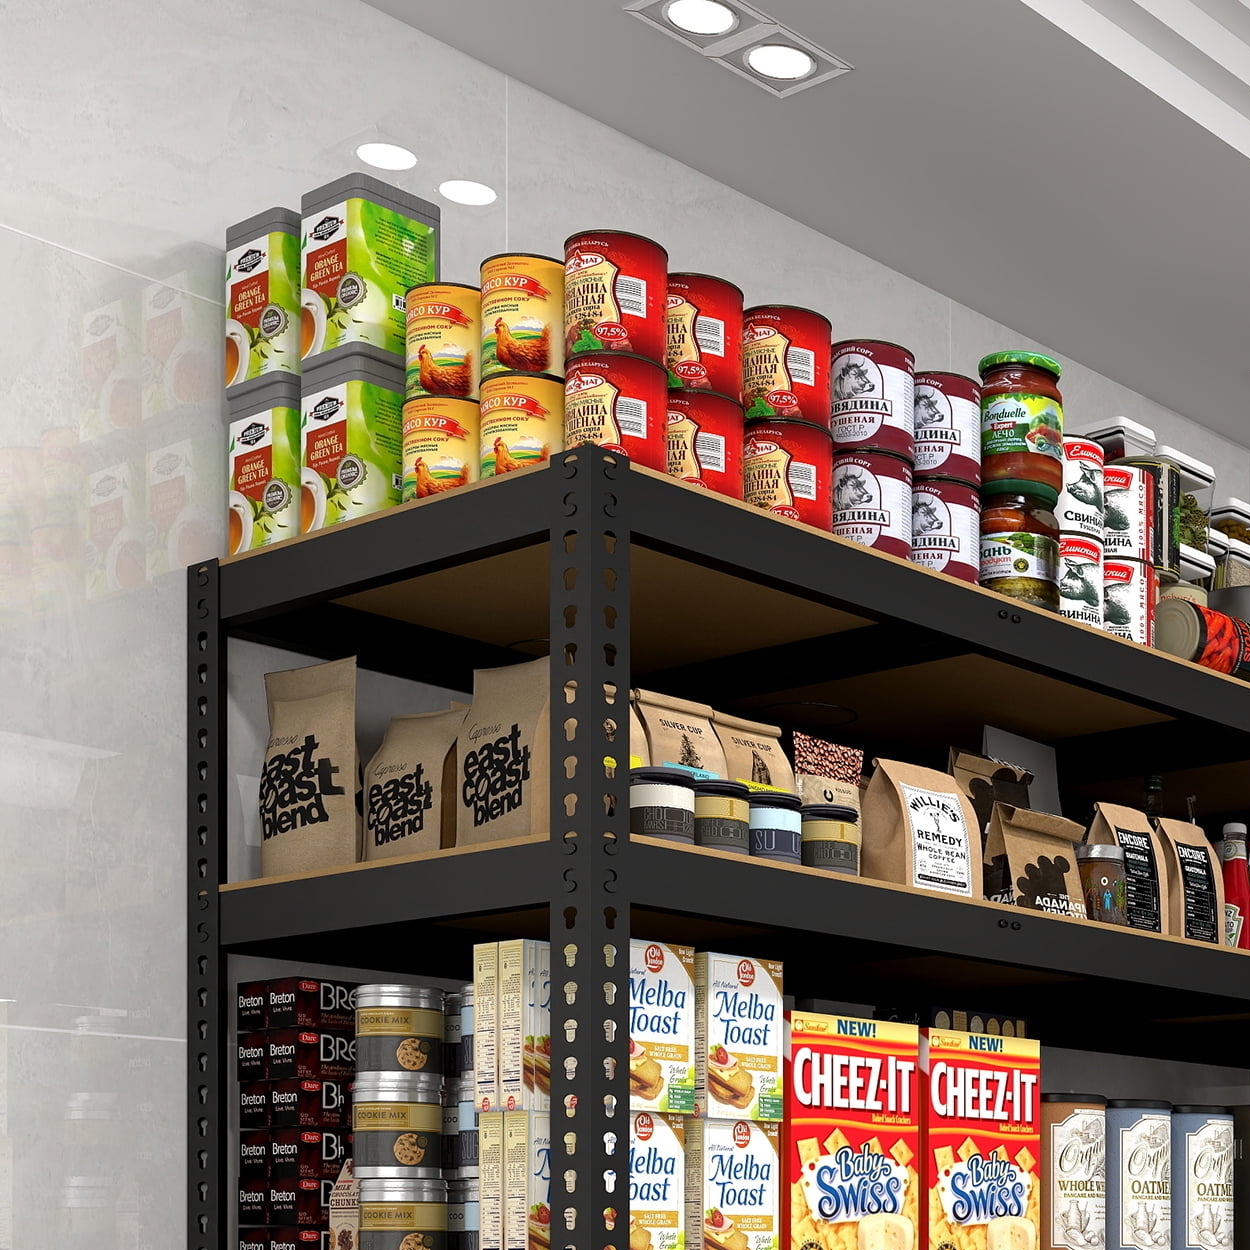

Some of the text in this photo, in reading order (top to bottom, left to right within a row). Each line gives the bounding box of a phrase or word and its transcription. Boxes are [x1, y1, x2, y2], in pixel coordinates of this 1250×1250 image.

[314, 253, 339, 270] ORANGE
[310, 261, 343, 282] GREEN TEA
[504, 275, 528, 287] КУР
[427, 305, 451, 315] КУР
[565, 293, 605, 312] УШЕНАЯ
[856, 346, 874, 357] СОРТ
[926, 379, 943, 388] СОРТ
[504, 396, 527, 407] КУР
[832, 400, 889, 413] ВЯДИНА
[984, 407, 1027, 422] Bonduelle
[992, 430, 1015, 439] ЛЕЧО
[993, 422, 1013, 430] Expert
[314, 434, 339, 450] ORANGE
[914, 430, 957, 441] ЯДИНА
[310, 442, 343, 461] GREEN TEA
[241, 459, 264, 474] ORANGE
[854, 458, 872, 467] СОРТ
[237, 467, 269, 485] GREEN TEA
[833, 511, 886, 523] ВЯДИНА
[1060, 609, 1102, 625] ВИНИНА
[659, 718, 703, 736] SILVER CUP
[463, 723, 522, 774] east
[731, 736, 773, 753] SILVER CUP
[369, 763, 426, 804] east
[462, 744, 531, 808] coast
[367, 780, 433, 830] coast
[473, 786, 523, 828] blend
[910, 796, 960, 823] WILLIE'S
[263, 796, 329, 841] blend
[374, 808, 424, 847] blend
[917, 829, 963, 847] REMEDY
[1118, 832, 1150, 850] ENCORE
[917, 843, 966, 860] WHOLE BEAN
[928, 853, 956, 864] COFFEE
[1177, 845, 1208, 863] ENCORE
[238, 995, 264, 1008] Breton
[269, 992, 296, 1005] Breton
[630, 977, 686, 1009] Melba
[712, 991, 775, 1022] Melba
[360, 1016, 389, 1025] COOKIE
[391, 1016, 409, 1025] MIX
[630, 1006, 681, 1035] Toast
[836, 1019, 877, 1038] NEW!
[720, 1017, 771, 1046] Toast
[238, 1046, 264, 1059] Breton
[269, 1043, 296, 1057] Breton
[968, 1035, 1004, 1053] NEW!
[793, 1047, 915, 1113] CHEEZ-IT
[272, 1091, 298, 1105] Breton
[931, 1061, 1037, 1123] CHEEZ-IT
[708, 1154, 771, 1181] Melba
[836, 1143, 891, 1183] Baby
[968, 1151, 1016, 1187] Baby
[335, 1184, 351, 1192] MILK
[630, 1176, 671, 1202] oast
[716, 1181, 766, 1208] Toast
[818, 1165, 901, 1218] Swiss
[1058, 1180, 1095, 1192] WHOLE
[1131, 1180, 1171, 1195] OATME
[1197, 1183, 1233, 1197] OATME
[952, 1171, 1025, 1223] Swiss
[363, 1211, 413, 1220] COOKIE MIX
